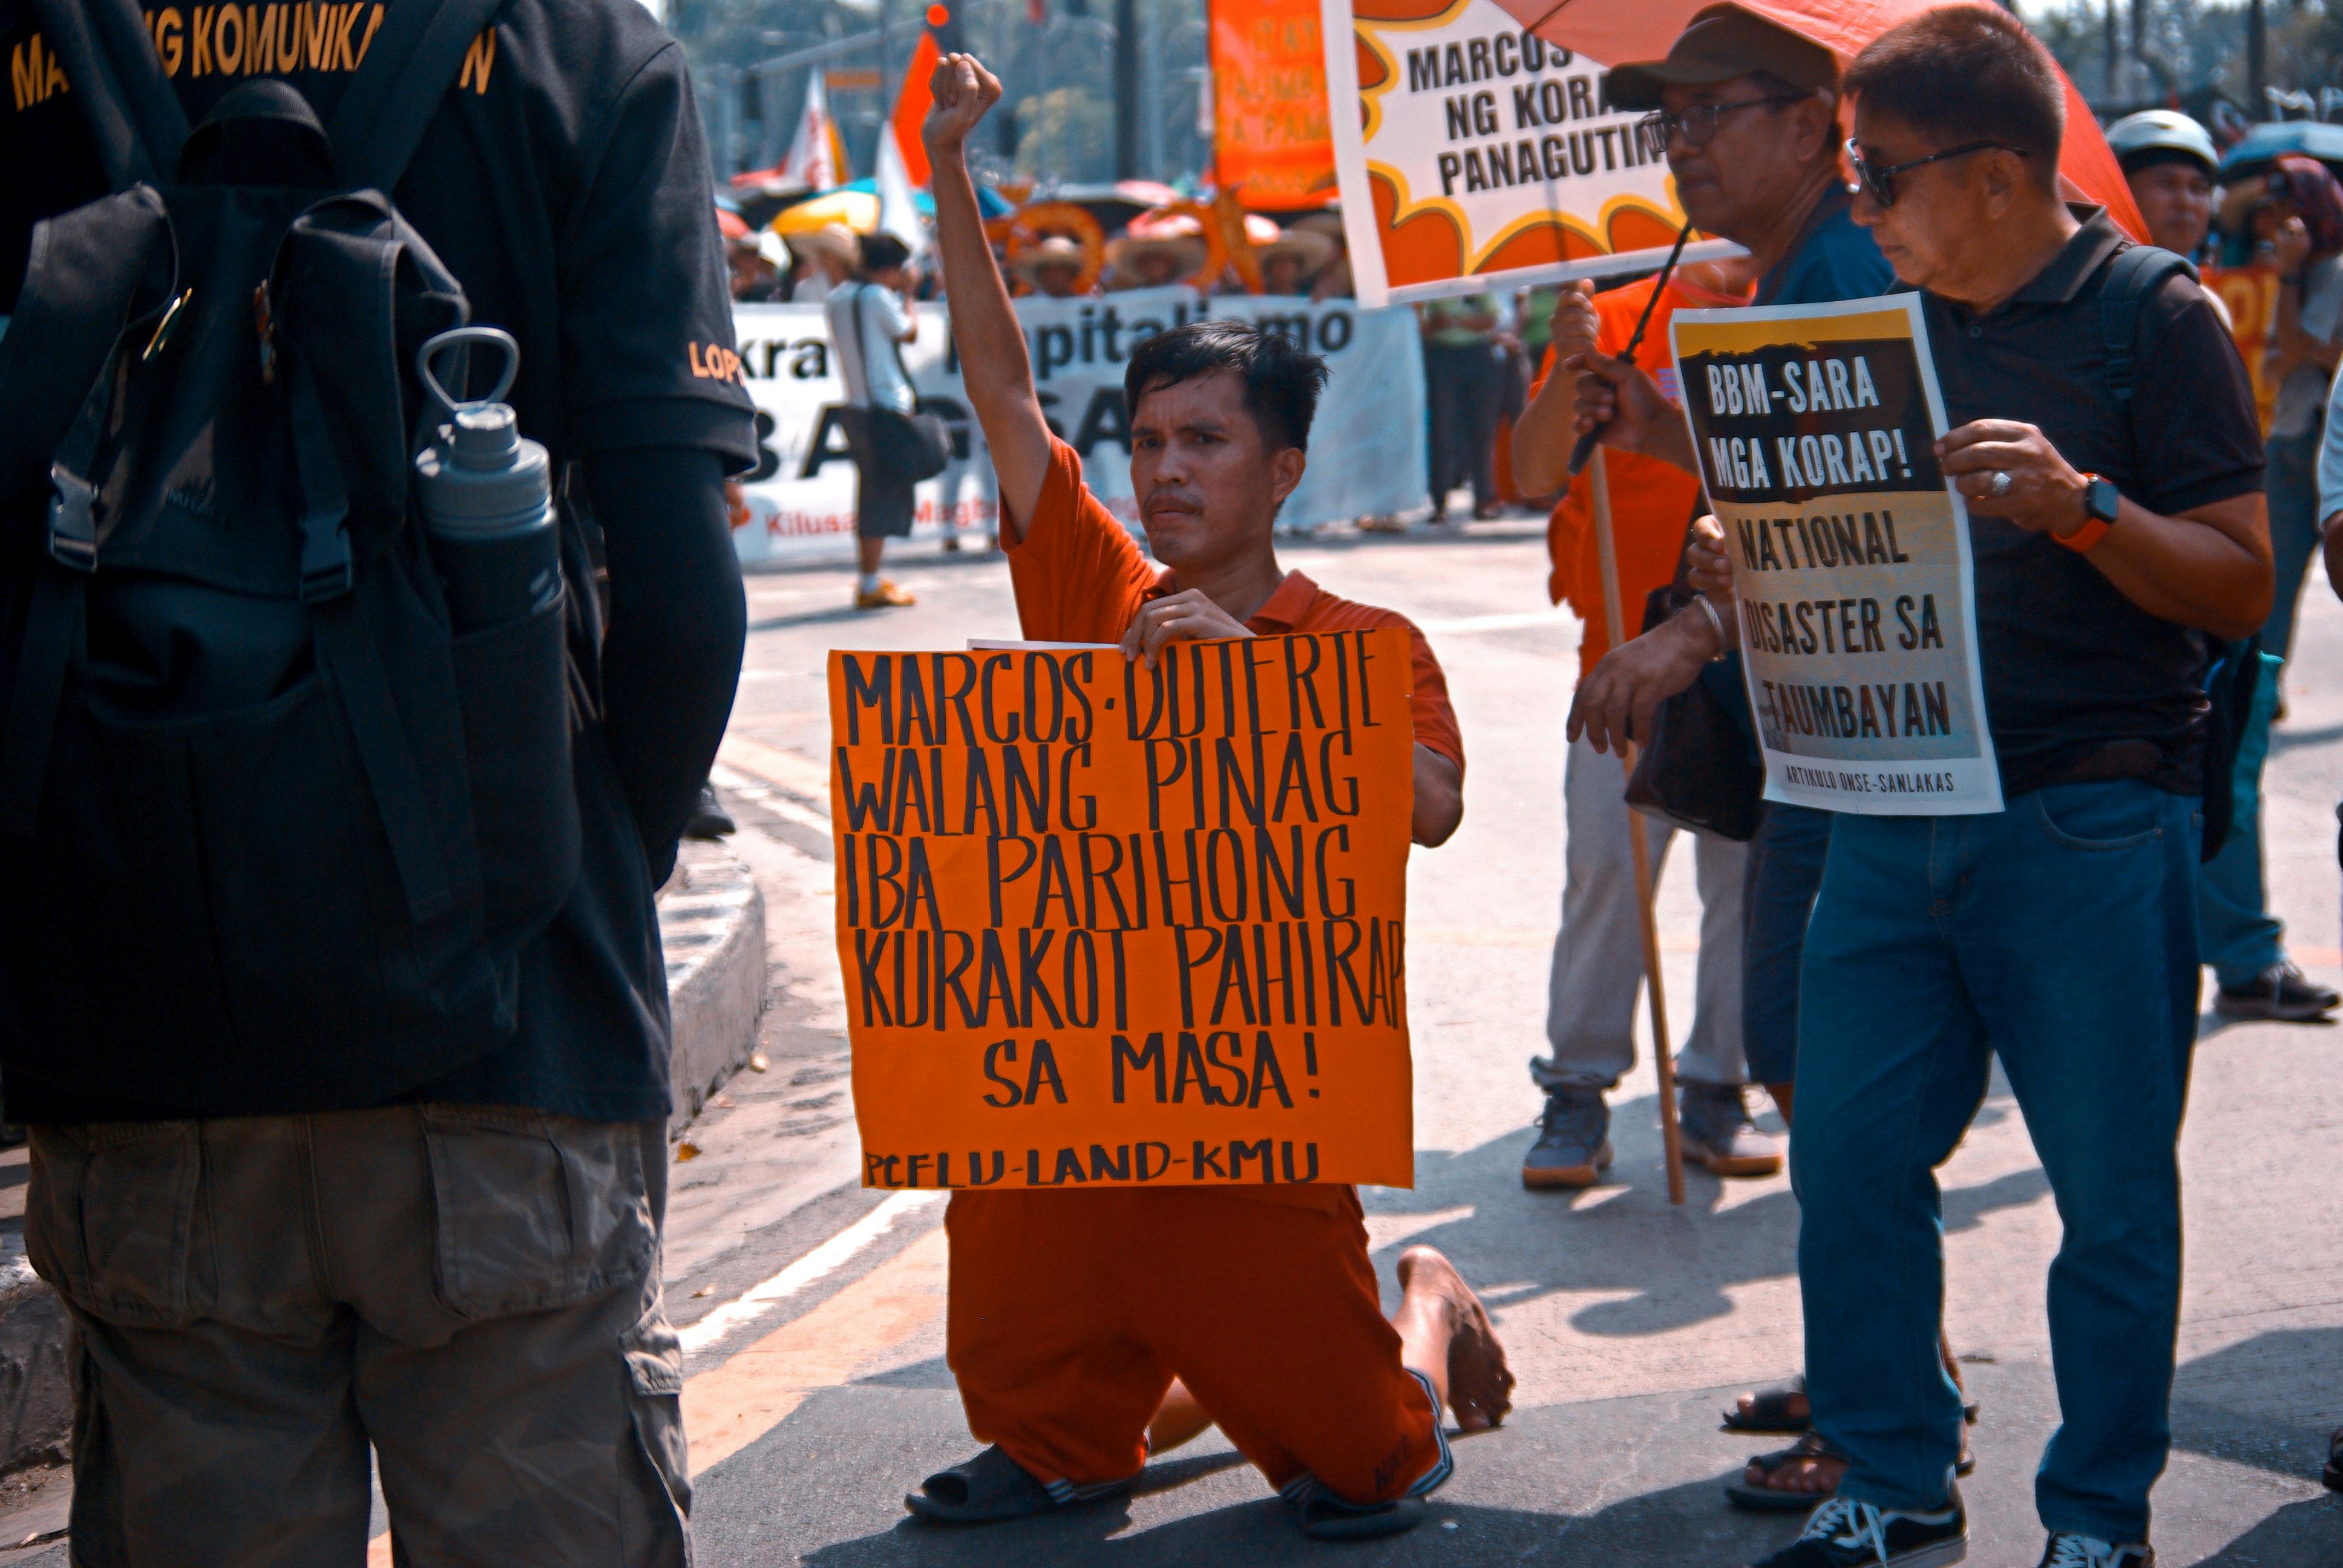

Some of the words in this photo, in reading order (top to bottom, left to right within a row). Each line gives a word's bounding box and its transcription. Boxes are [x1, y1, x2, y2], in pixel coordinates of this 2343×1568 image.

[1444, 90, 1499, 142] NG
[1513, 69, 1629, 129] KOR
[1438, 121, 1663, 197] PANAGUTIN
[687, 339, 746, 387] LOP
[1706, 356, 1880, 417] BBM-SARA
[1709, 436, 1770, 490] MGA
[1778, 428, 1912, 488] KORAP!
[1737, 510, 1909, 572] NATIONAL
[1745, 596, 1886, 655] DISASTER
[1898, 594, 1944, 650] SA
[1761, 681, 1951, 739] TAUMBAYAN
[837, 743, 1097, 837] WALANG
[1145, 729, 1360, 831] PINAG
[1786, 765, 1837, 789] ARTIKULO
[1840, 772, 1955, 793] ONSE-SANLAKAS
[844, 833, 942, 930] IBA
[987, 825, 1356, 932] PARIHONG
[856, 927, 1129, 1031] KURAKOT
[1175, 917, 1403, 1030] PAHIRAP
[983, 1038, 1069, 1108] SA
[1111, 1031, 1321, 1108] MASA!
